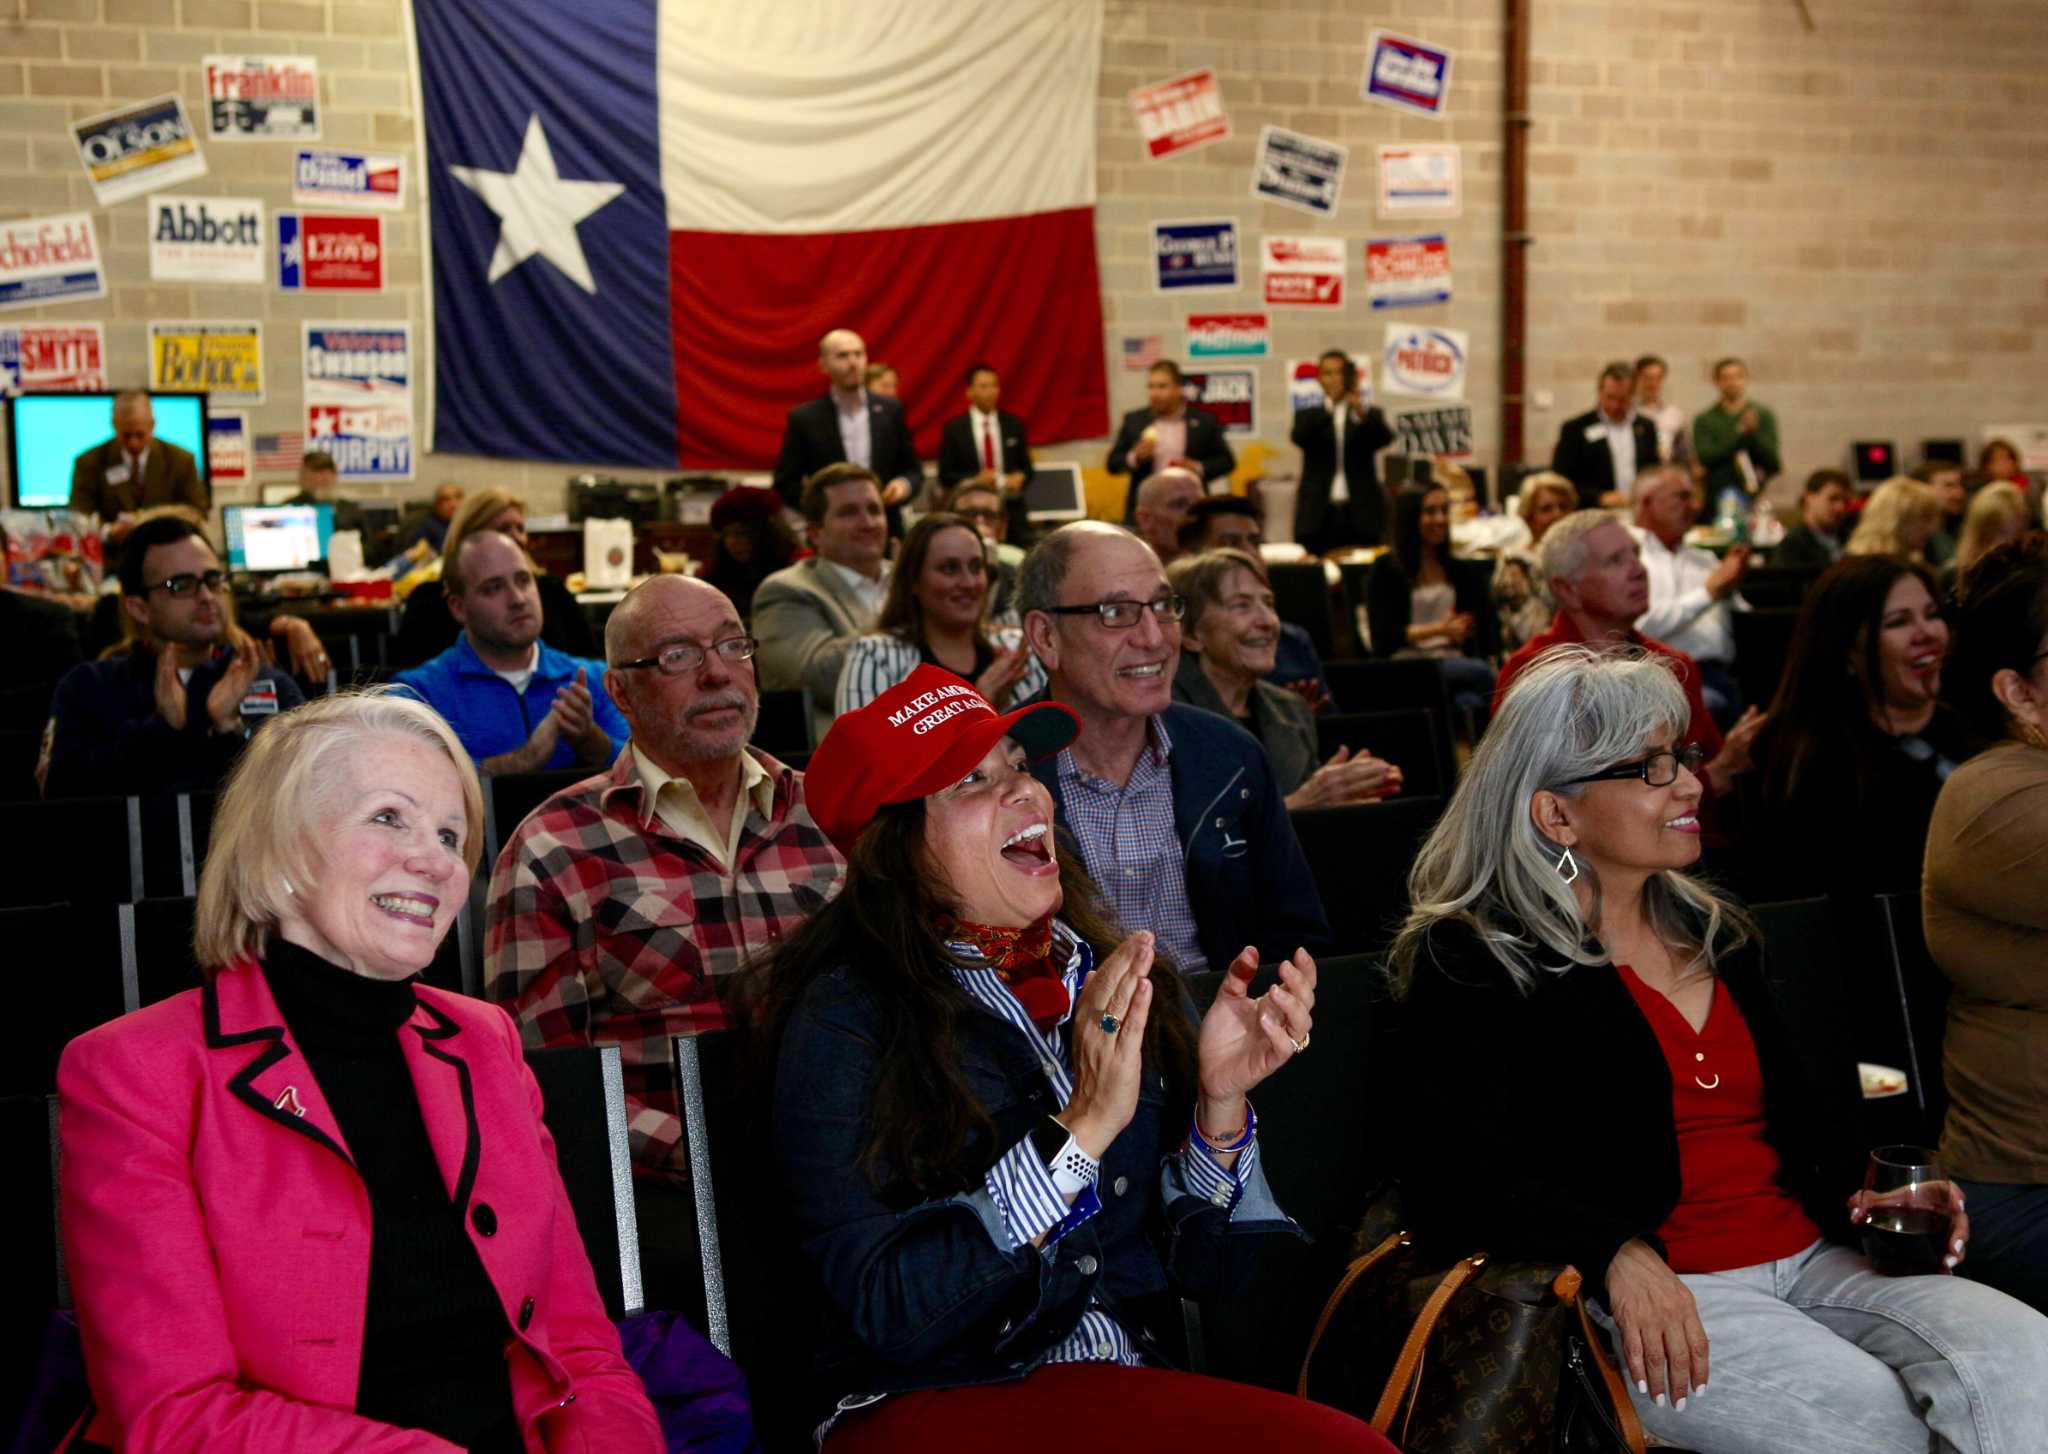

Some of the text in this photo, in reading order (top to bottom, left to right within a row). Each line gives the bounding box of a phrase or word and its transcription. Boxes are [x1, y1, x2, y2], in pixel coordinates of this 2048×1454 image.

[207, 63, 315, 98] Franklin
[156, 204, 258, 245] Abbott
[0, 222, 93, 270] chofield
[20, 336, 100, 371] SMYTH
[888, 691, 940, 728] MAKE
[913, 701, 966, 735] GREAT
